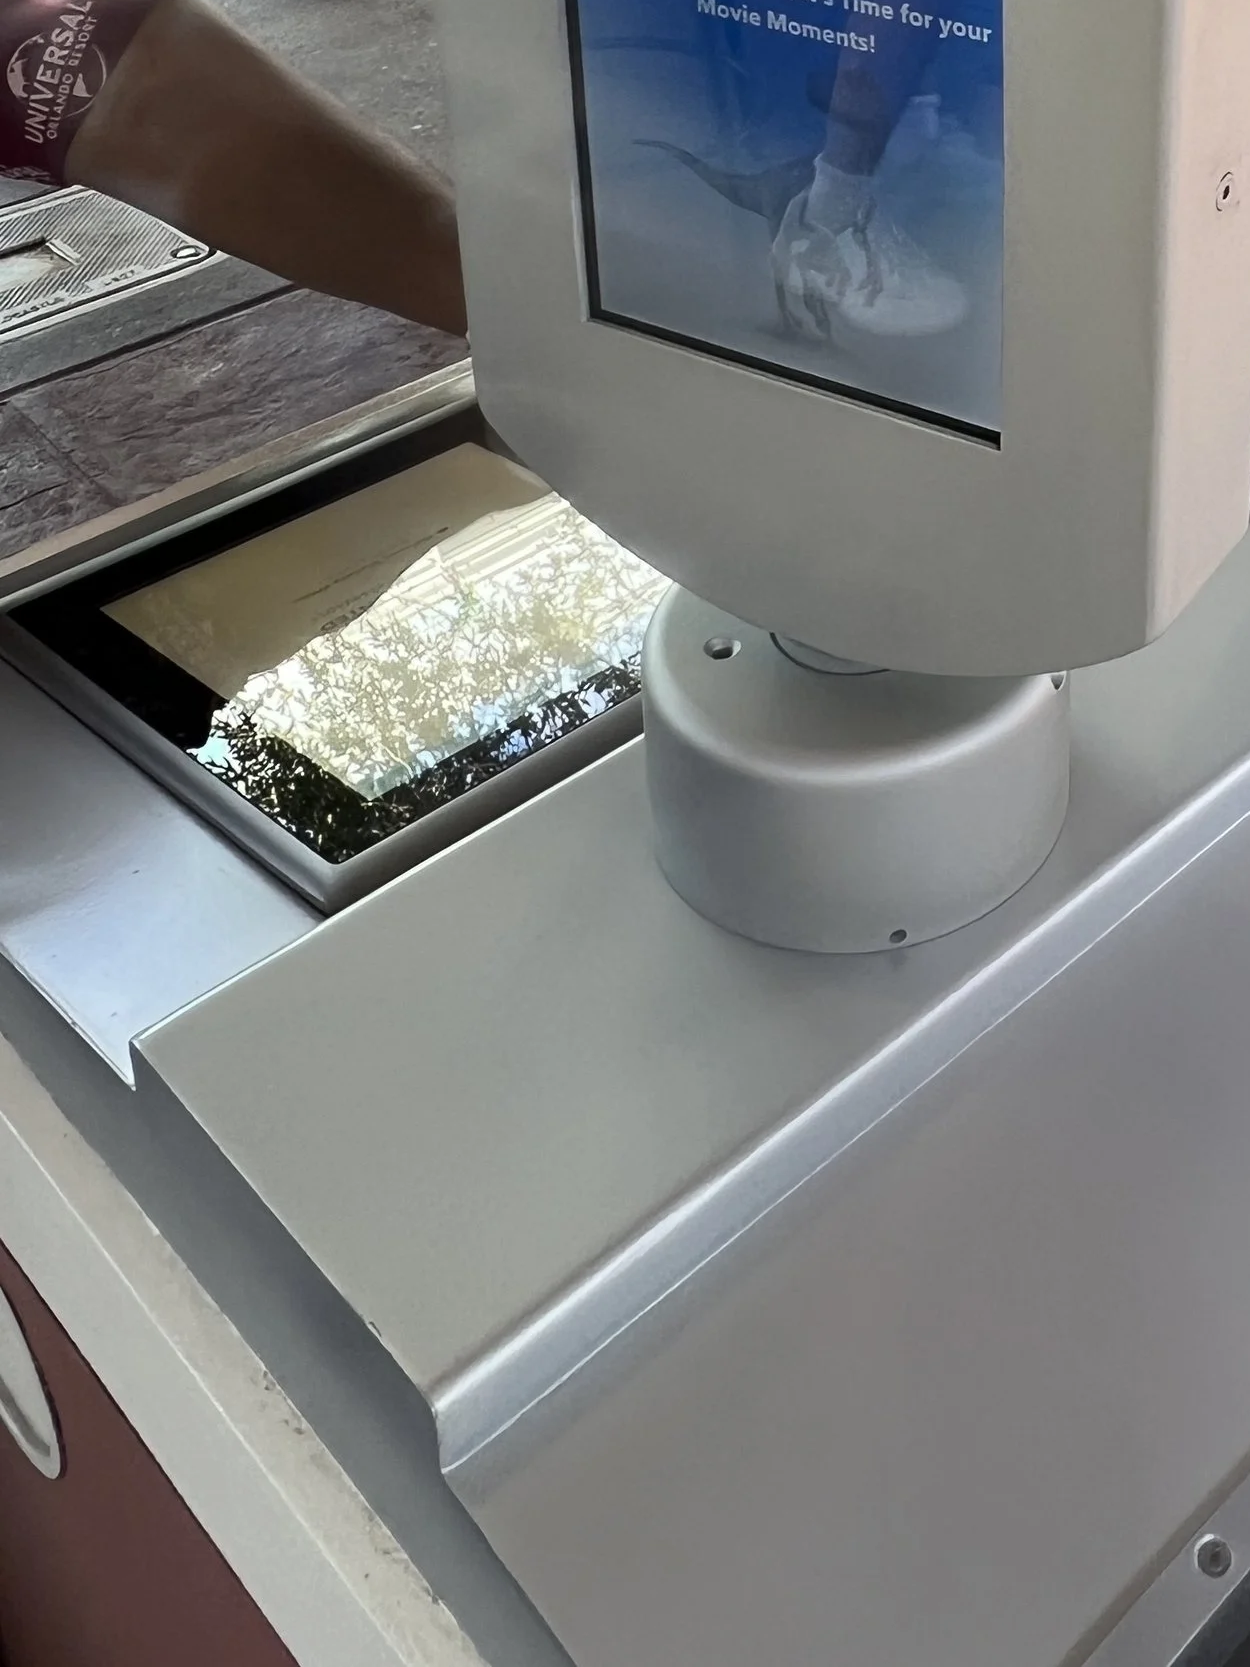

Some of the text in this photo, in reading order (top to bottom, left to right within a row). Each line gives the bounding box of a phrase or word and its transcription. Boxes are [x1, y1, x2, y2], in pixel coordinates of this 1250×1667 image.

[767, 9, 876, 54] Moments!
[899, 2, 934, 30] for
[938, 16, 993, 44] your
[24, 0, 94, 145] UNIVERSAL
[46, 72, 74, 140] ORLANDO
